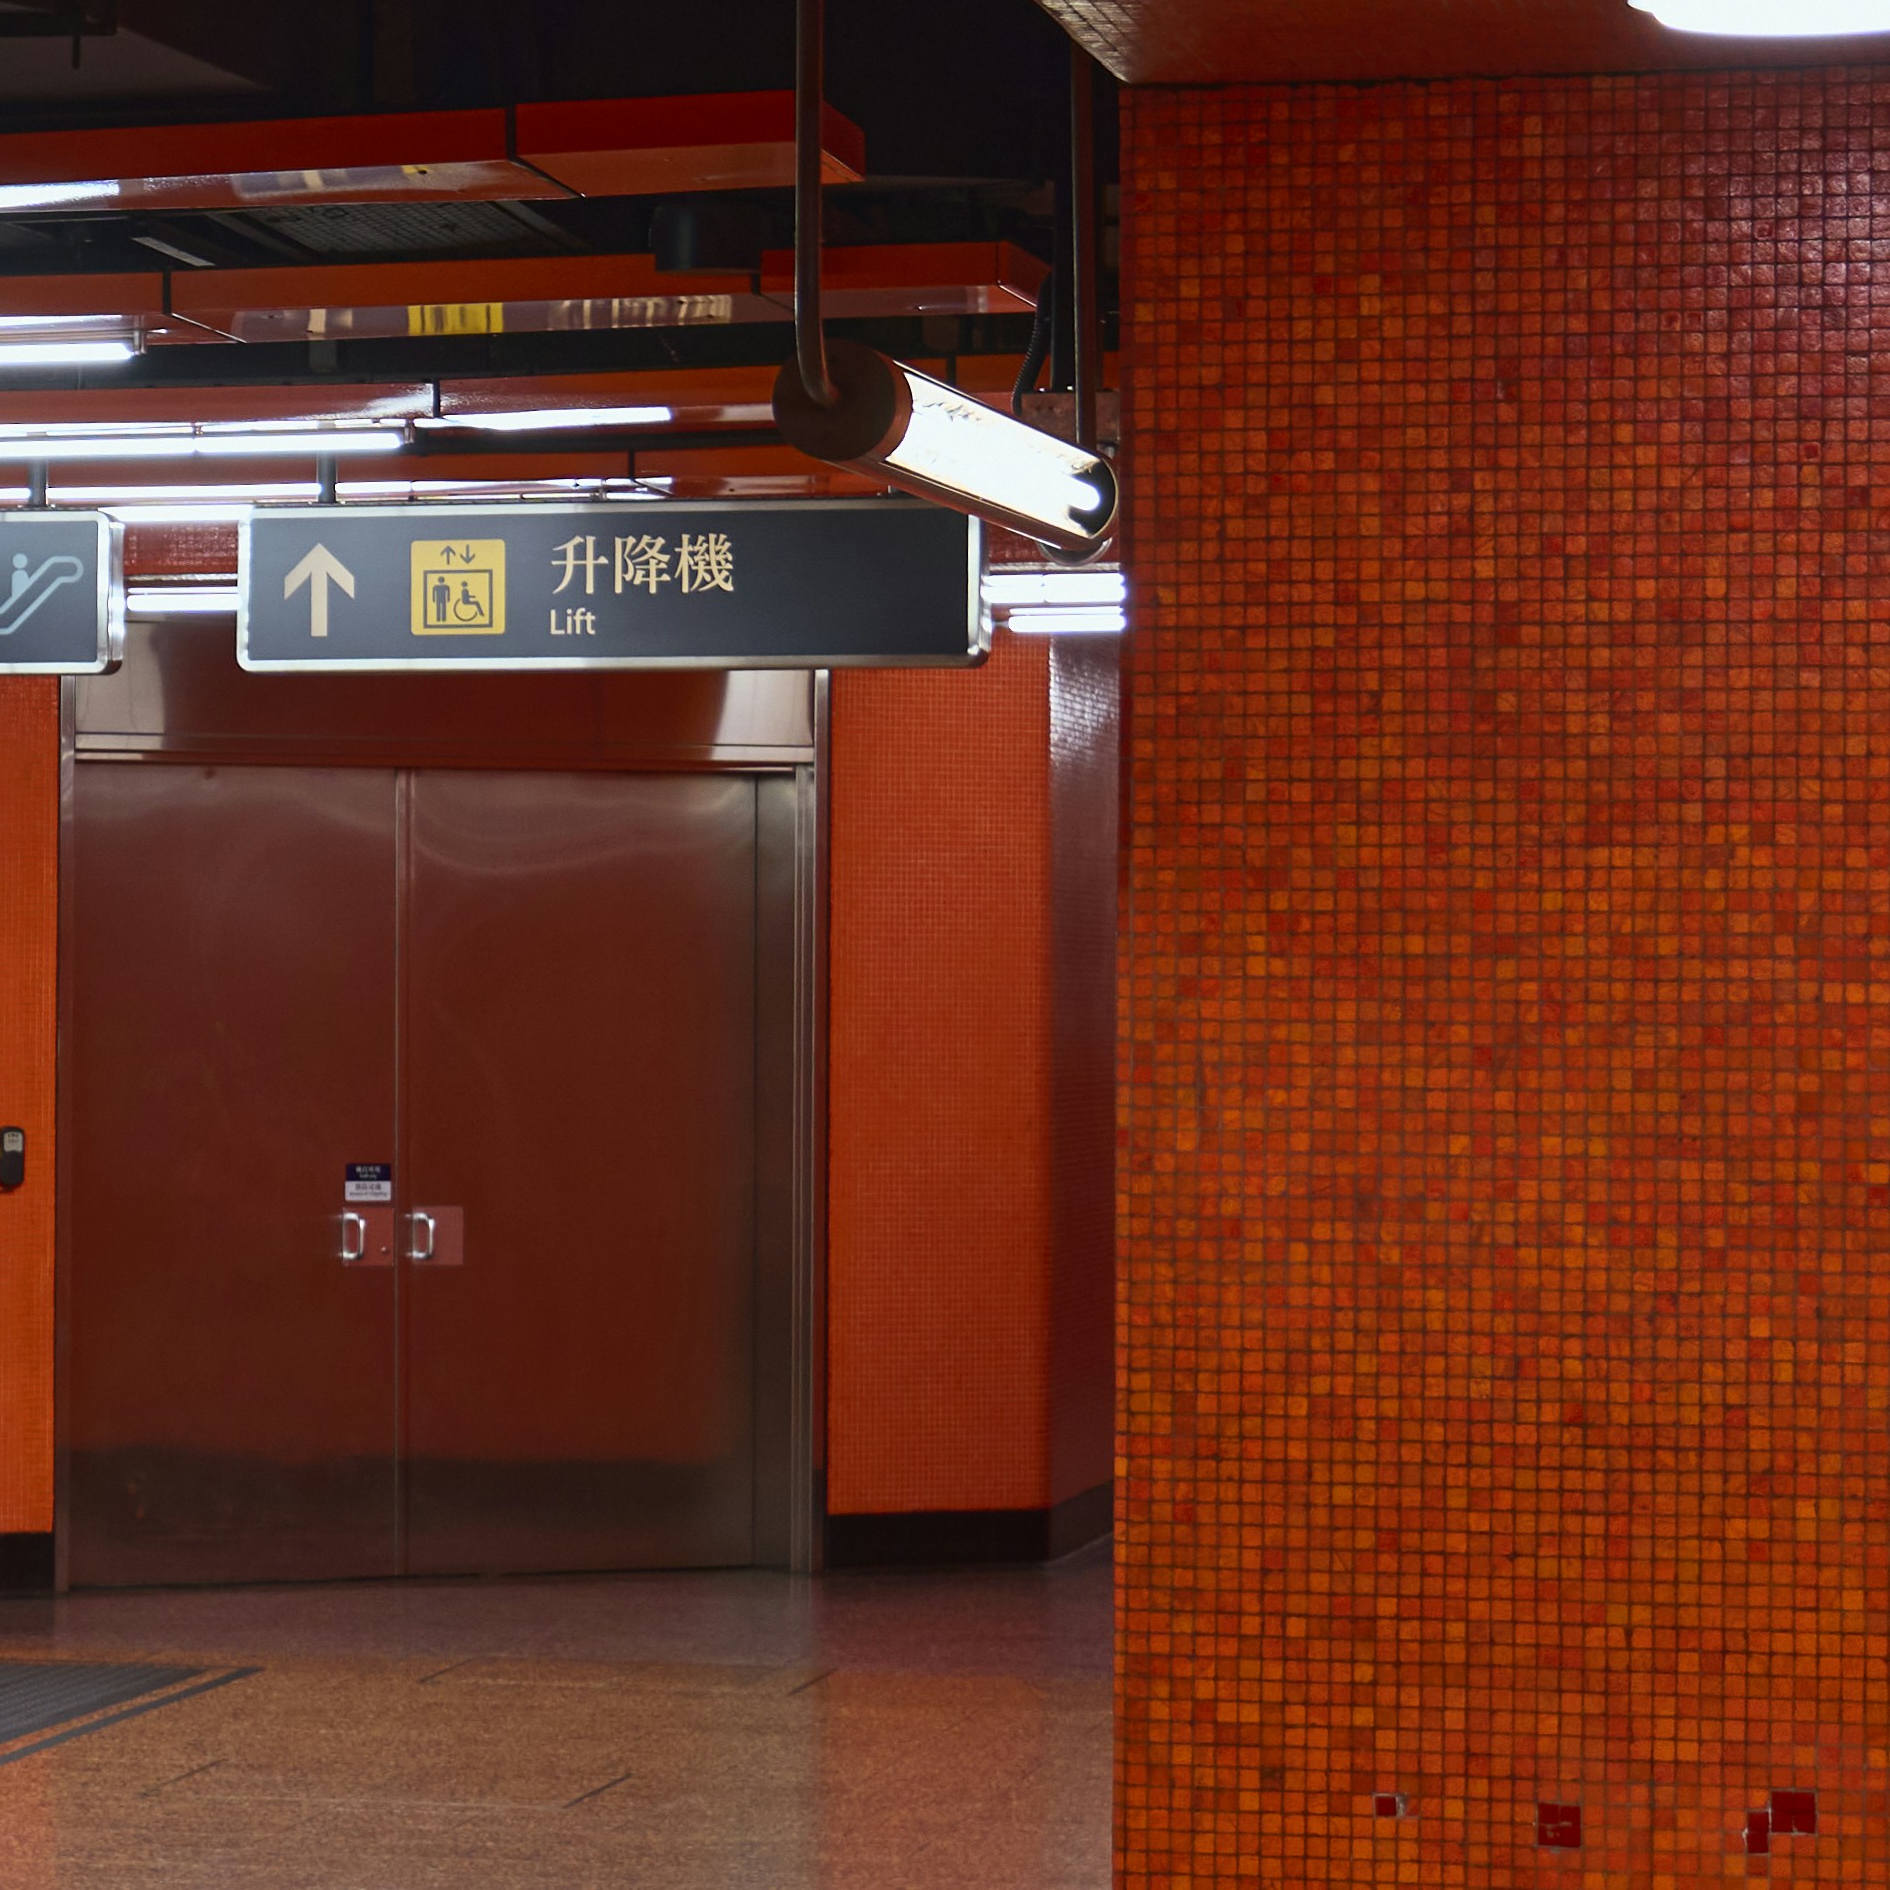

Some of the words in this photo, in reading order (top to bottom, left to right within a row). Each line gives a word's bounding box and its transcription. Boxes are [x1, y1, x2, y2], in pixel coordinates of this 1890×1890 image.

[551, 533, 735, 594] 升降機
[550, 607, 596, 635] Lift
